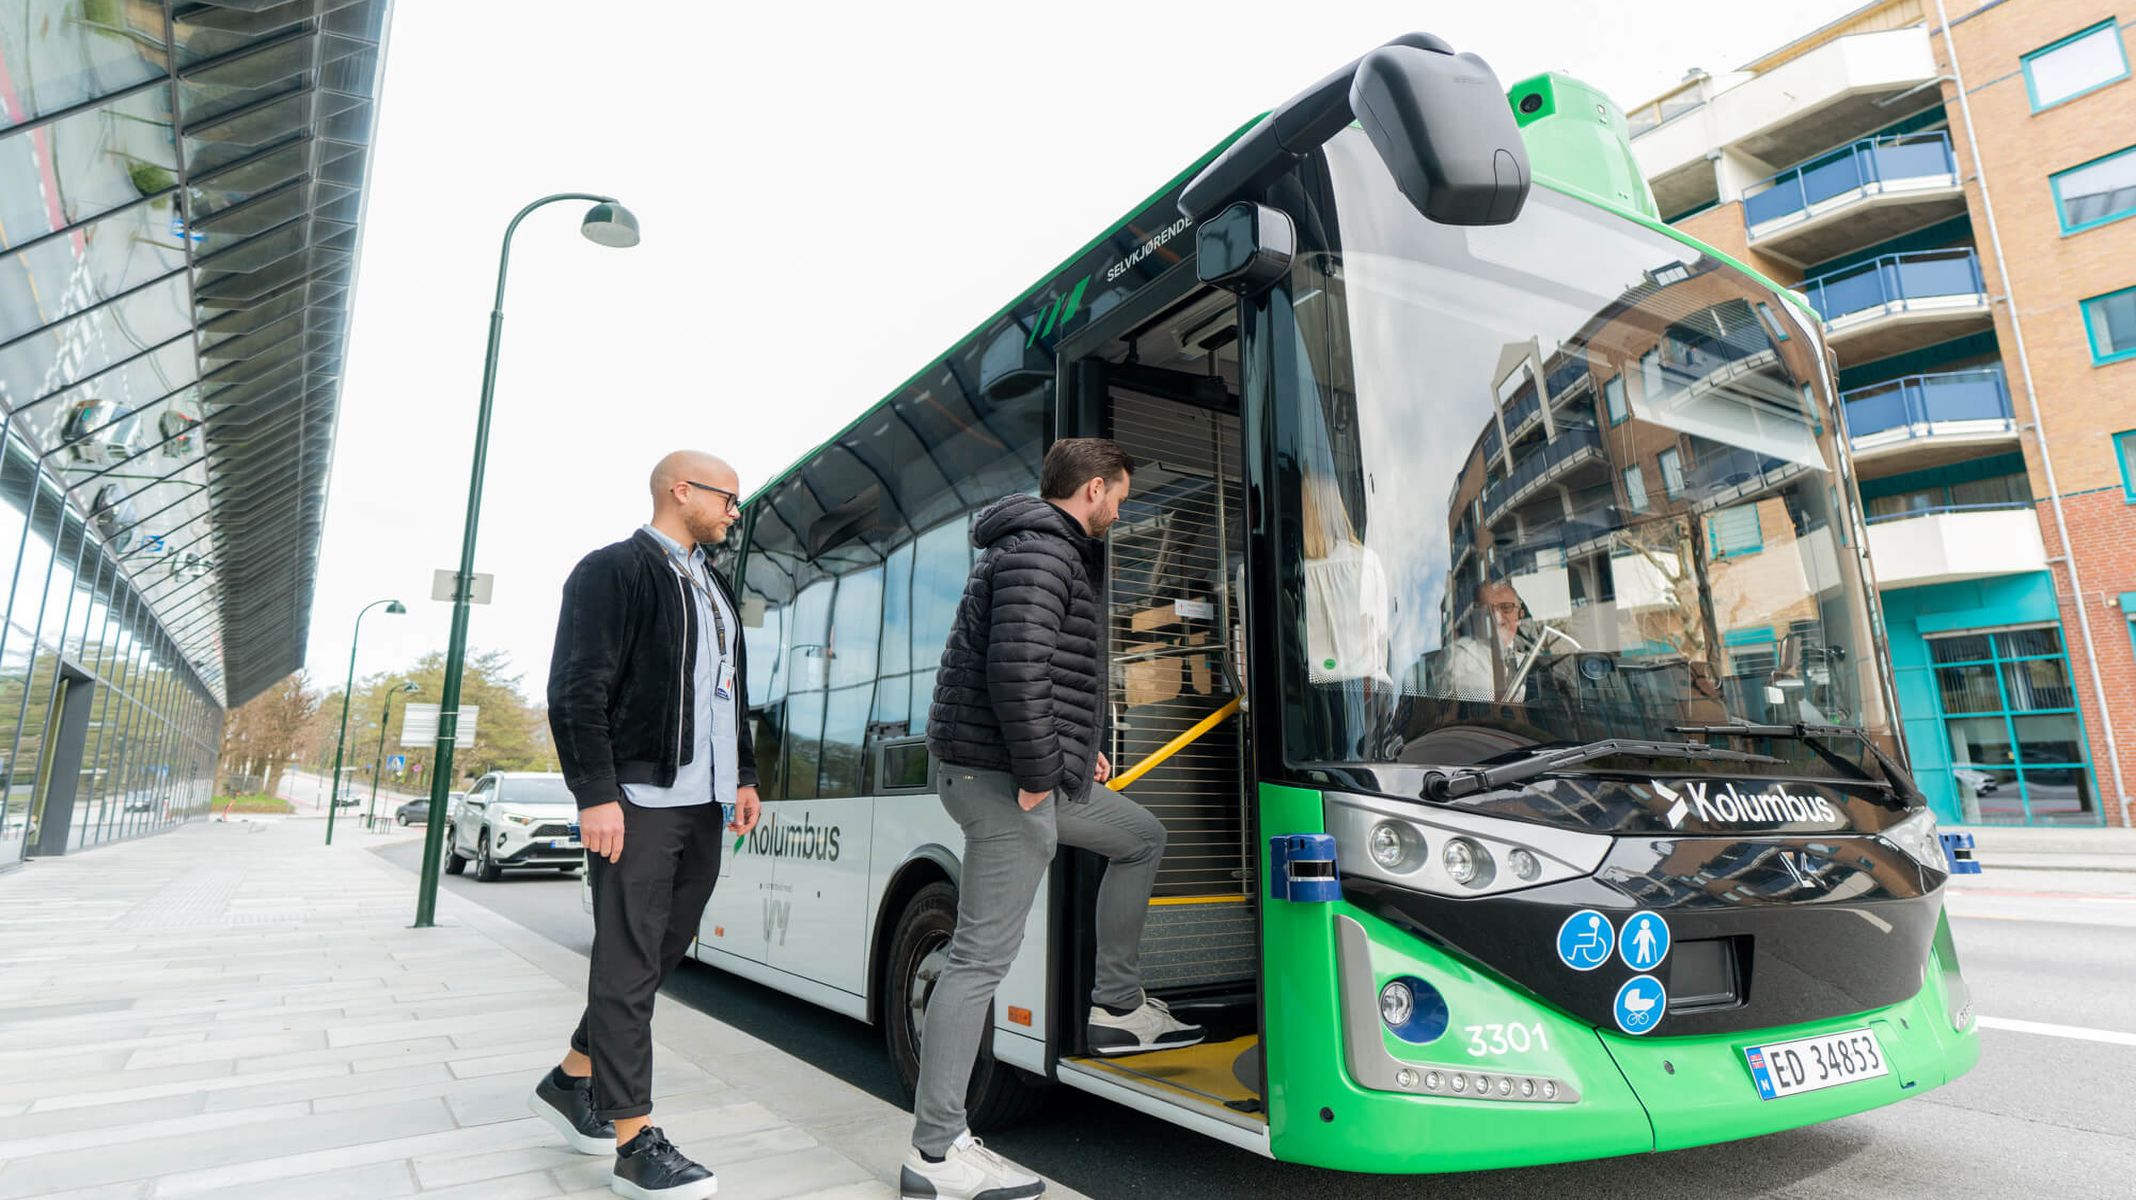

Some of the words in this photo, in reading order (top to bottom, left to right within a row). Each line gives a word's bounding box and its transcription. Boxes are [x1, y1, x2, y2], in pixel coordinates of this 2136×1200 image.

[1686, 782, 1836, 823] Kolumbus
[1464, 1021, 1550, 1057] 3301
[1770, 1049, 1805, 1088] ED
[1810, 1036, 1879, 1080] 34853
[1760, 1078, 1771, 1091] N
